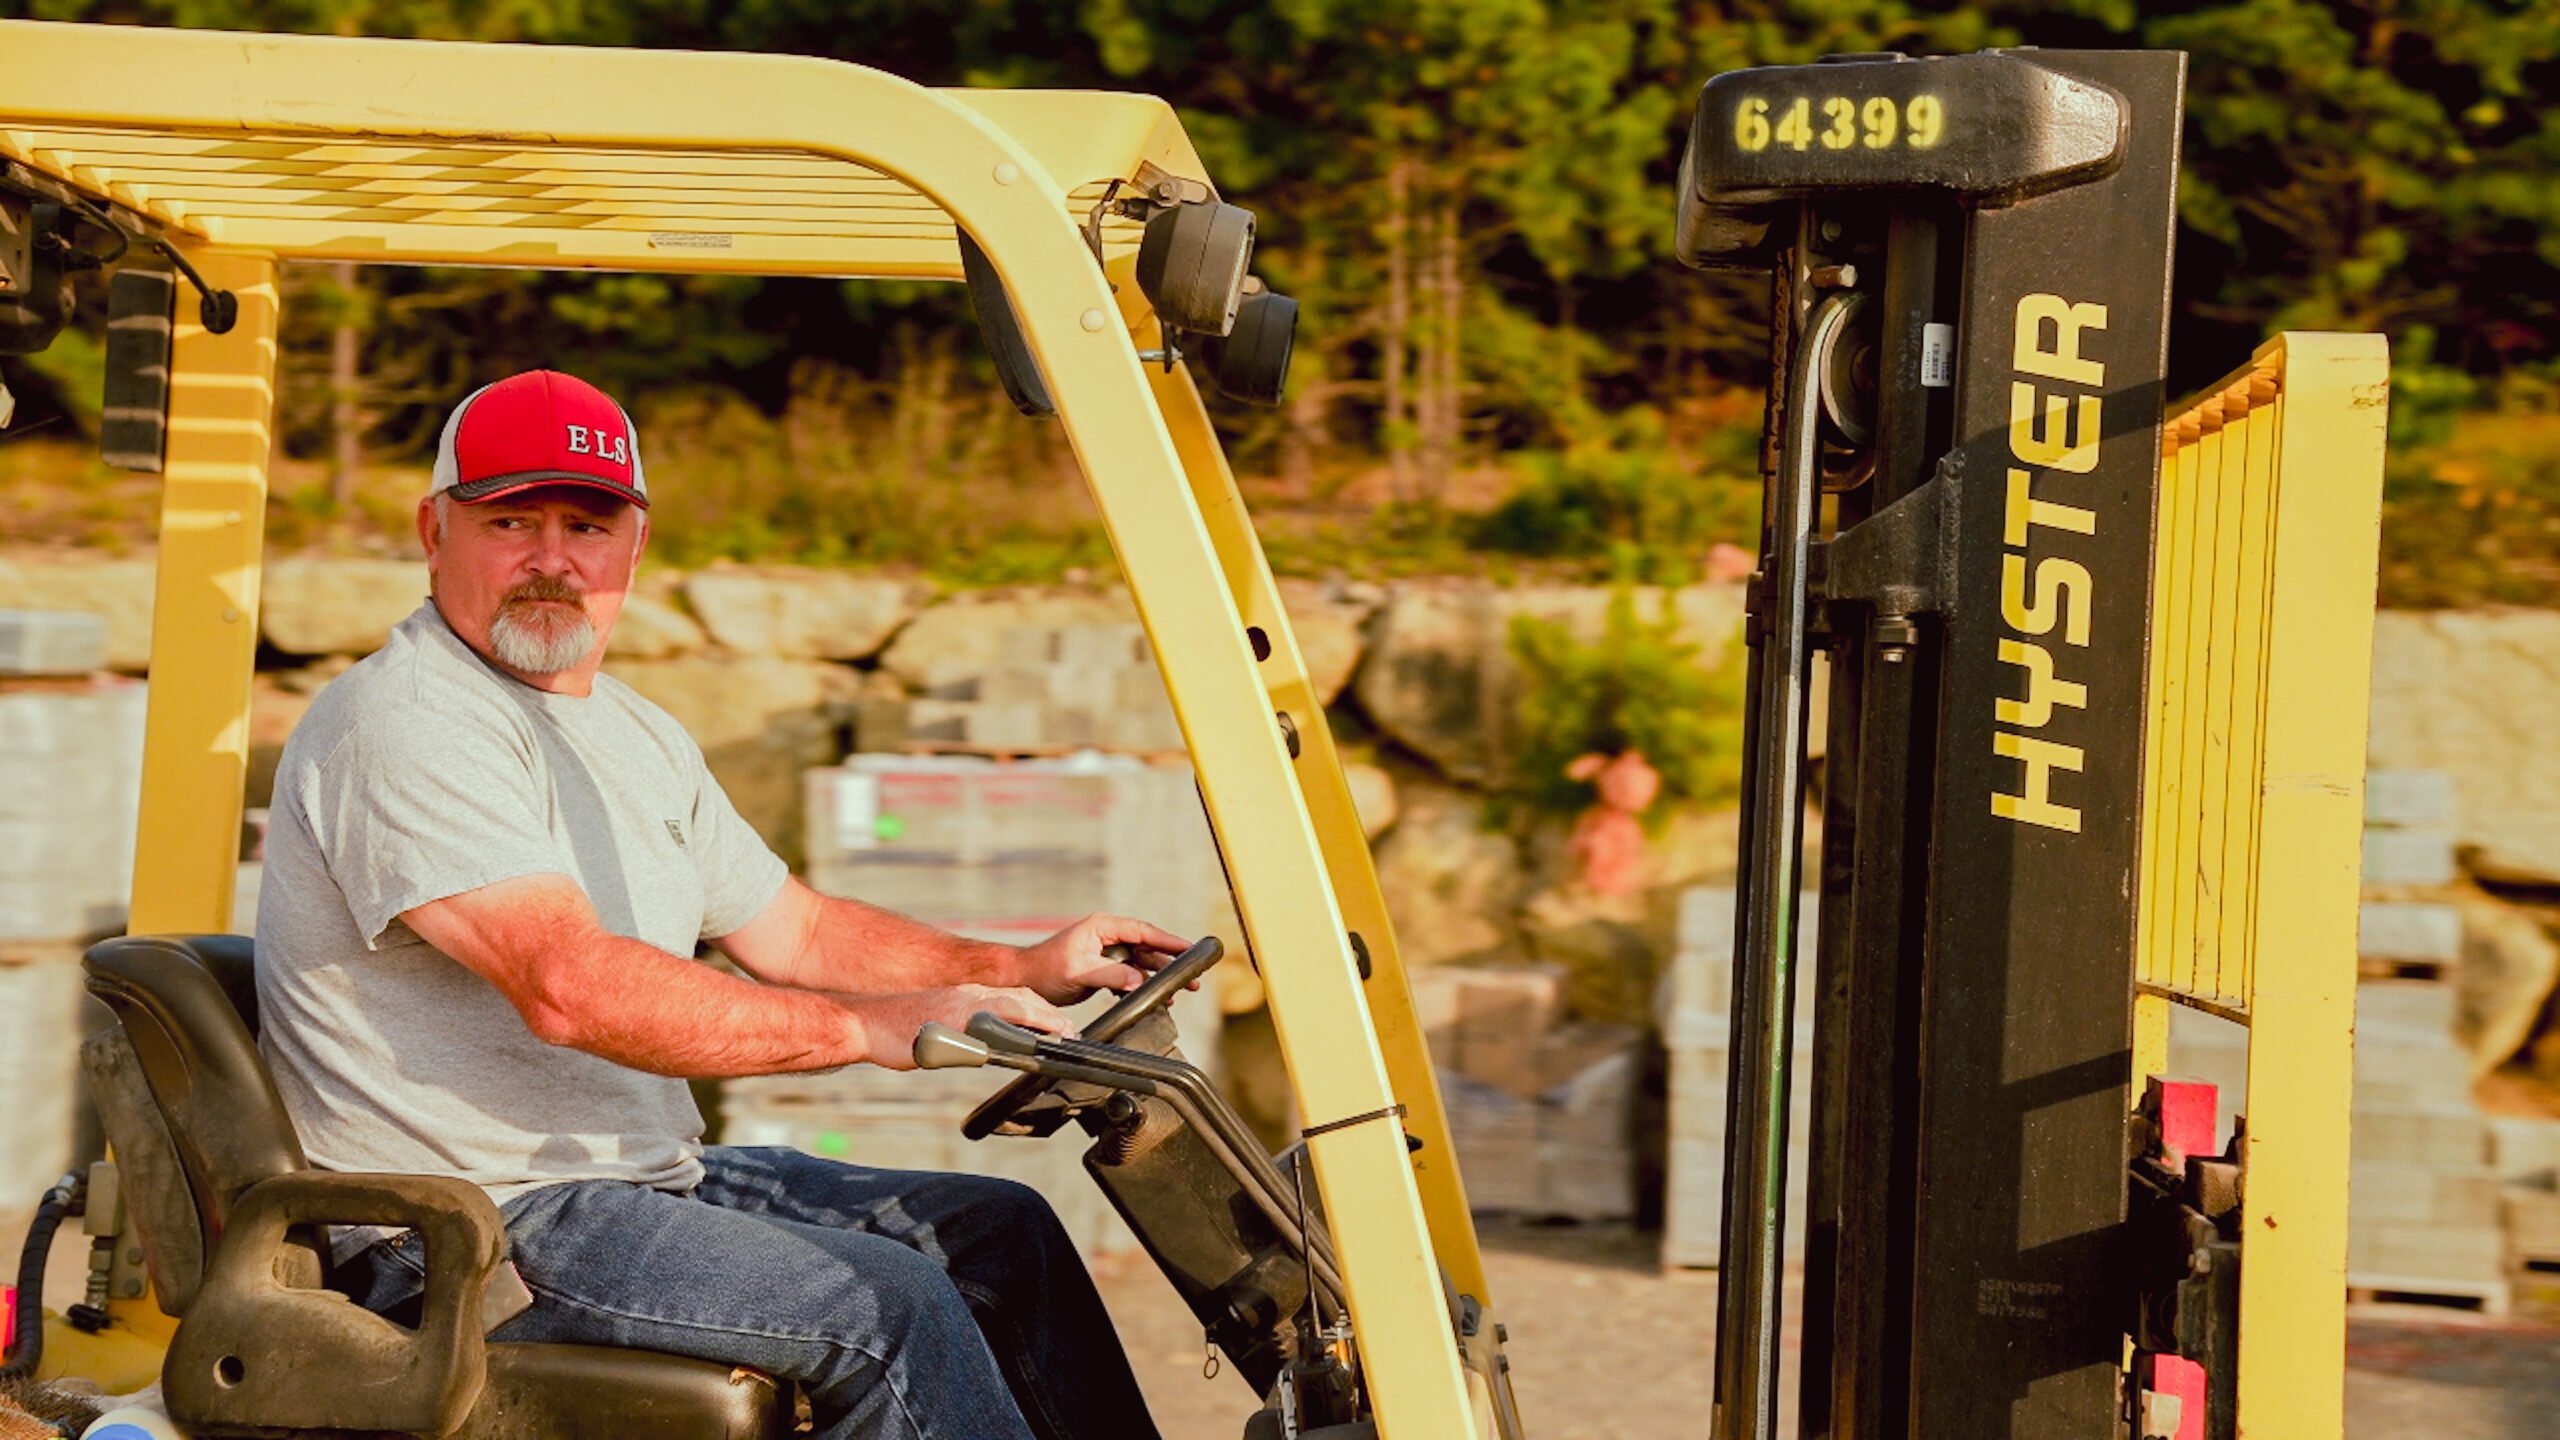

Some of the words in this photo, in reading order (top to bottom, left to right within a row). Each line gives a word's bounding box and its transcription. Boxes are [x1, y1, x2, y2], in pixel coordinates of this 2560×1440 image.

[1735, 94, 1942, 151] 64399
[566, 424, 627, 465] ELS
[1991, 292, 2107, 833] HYSTER
